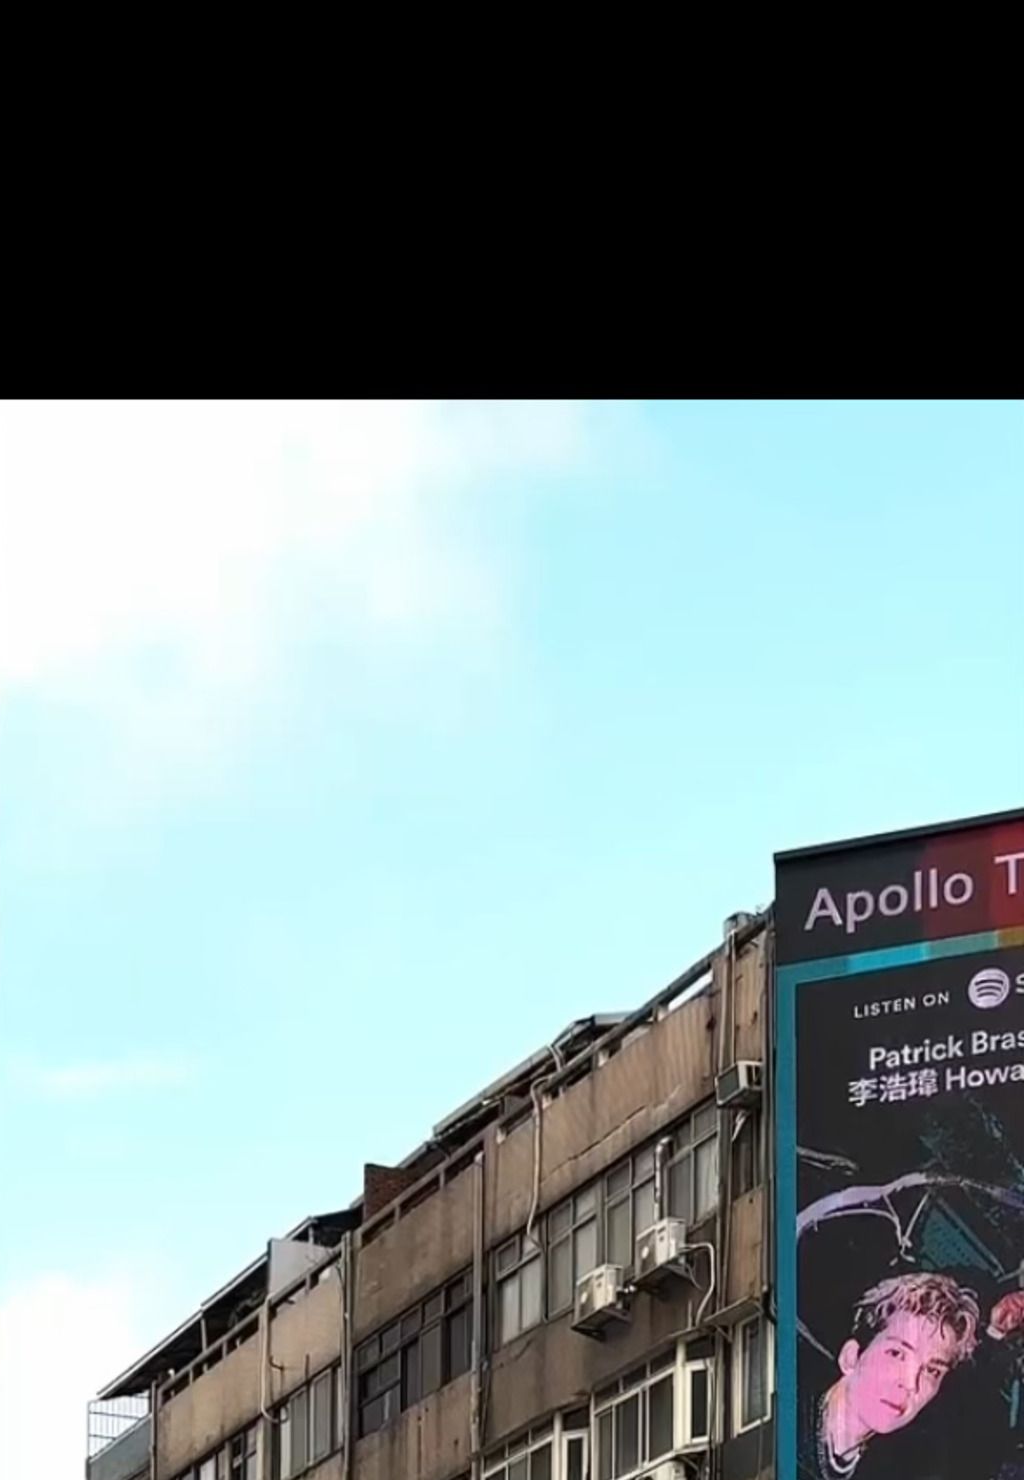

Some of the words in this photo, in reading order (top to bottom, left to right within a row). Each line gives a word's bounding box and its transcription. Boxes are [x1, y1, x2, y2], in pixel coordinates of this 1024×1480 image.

[805, 869, 973, 933] Apollo
[853, 996, 915, 1019] LISTEN
[922, 991, 950, 1006] ON
[869, 1036, 963, 1070] Patrick
[945, 1061, 1024, 1091] Howa
